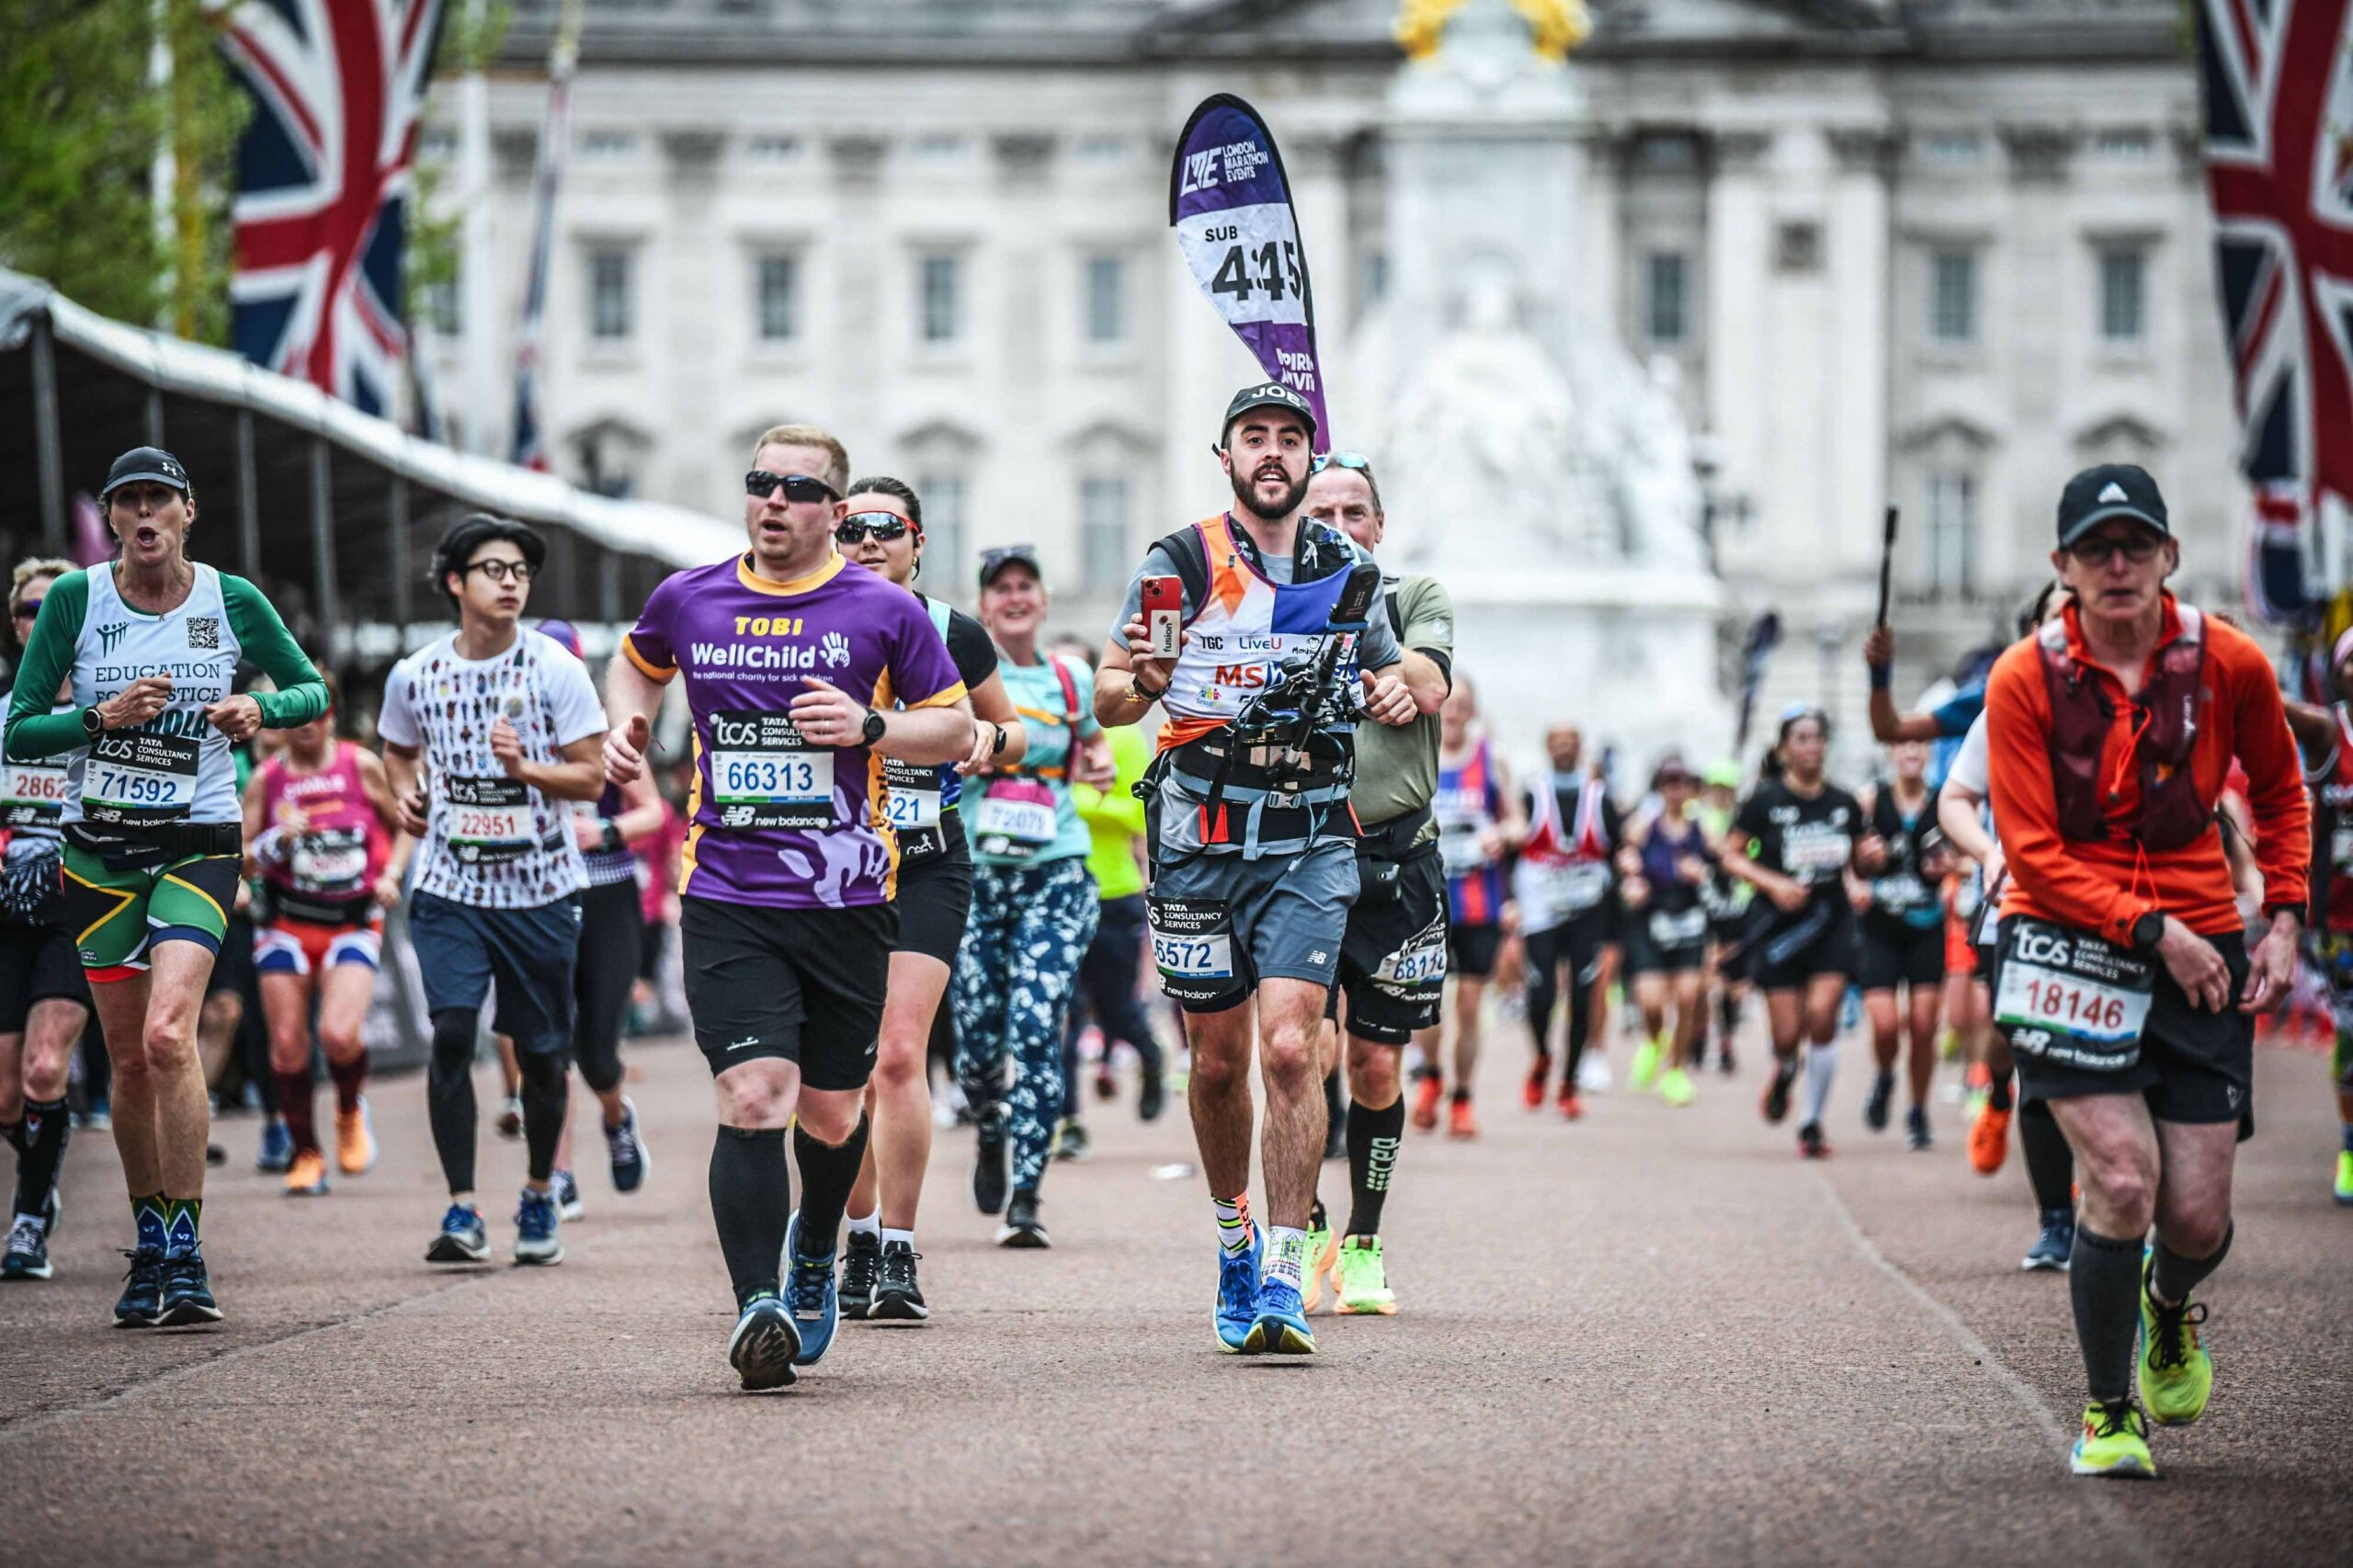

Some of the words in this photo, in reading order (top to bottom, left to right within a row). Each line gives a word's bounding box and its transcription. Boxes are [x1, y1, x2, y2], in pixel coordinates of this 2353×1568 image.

[1222, 141, 1256, 157] LONDON
[1224, 152, 1268, 169] MARATHON
[1226, 166, 1256, 182] EVENTS
[1205, 225, 1238, 242] SUB
[1211, 240, 1302, 301] 4:45
[1251, 385, 1301, 407] JOE
[735, 617, 803, 636] TOBI
[1199, 636, 1223, 650] TGC
[691, 642, 816, 668] WellChild
[96, 663, 221, 683] EDUCATION
[703, 671, 735, 679] national
[737, 672, 767, 682] charity
[768, 673, 779, 681] for
[782, 674, 798, 682] sick
[718, 716, 757, 744] tcs
[761, 717, 789, 726] TATA
[97, 735, 133, 759] tcs
[139, 737, 163, 747] TATA
[761, 737, 802, 746] SERVICES
[136, 755, 172, 767] SERVICES
[138, 746, 192, 761] CONSULTANCY
[729, 762, 813, 791] 66313
[884, 766, 933, 777] ONSULTANCY
[885, 774, 915, 784] ERVICES
[101, 771, 177, 802] 71592
[122, 818, 142, 827] new
[461, 812, 515, 835] 22951
[756, 817, 778, 826] new
[1163, 903, 1188, 912] TATA
[1164, 912, 1222, 921] CONSULTANCY
[1164, 920, 1201, 929] SERVICES
[1154, 939, 1212, 968] 6572
[2017, 926, 2070, 965] tcs
[1167, 987, 1183, 996] new
[2027, 979, 2125, 1029] 18146
